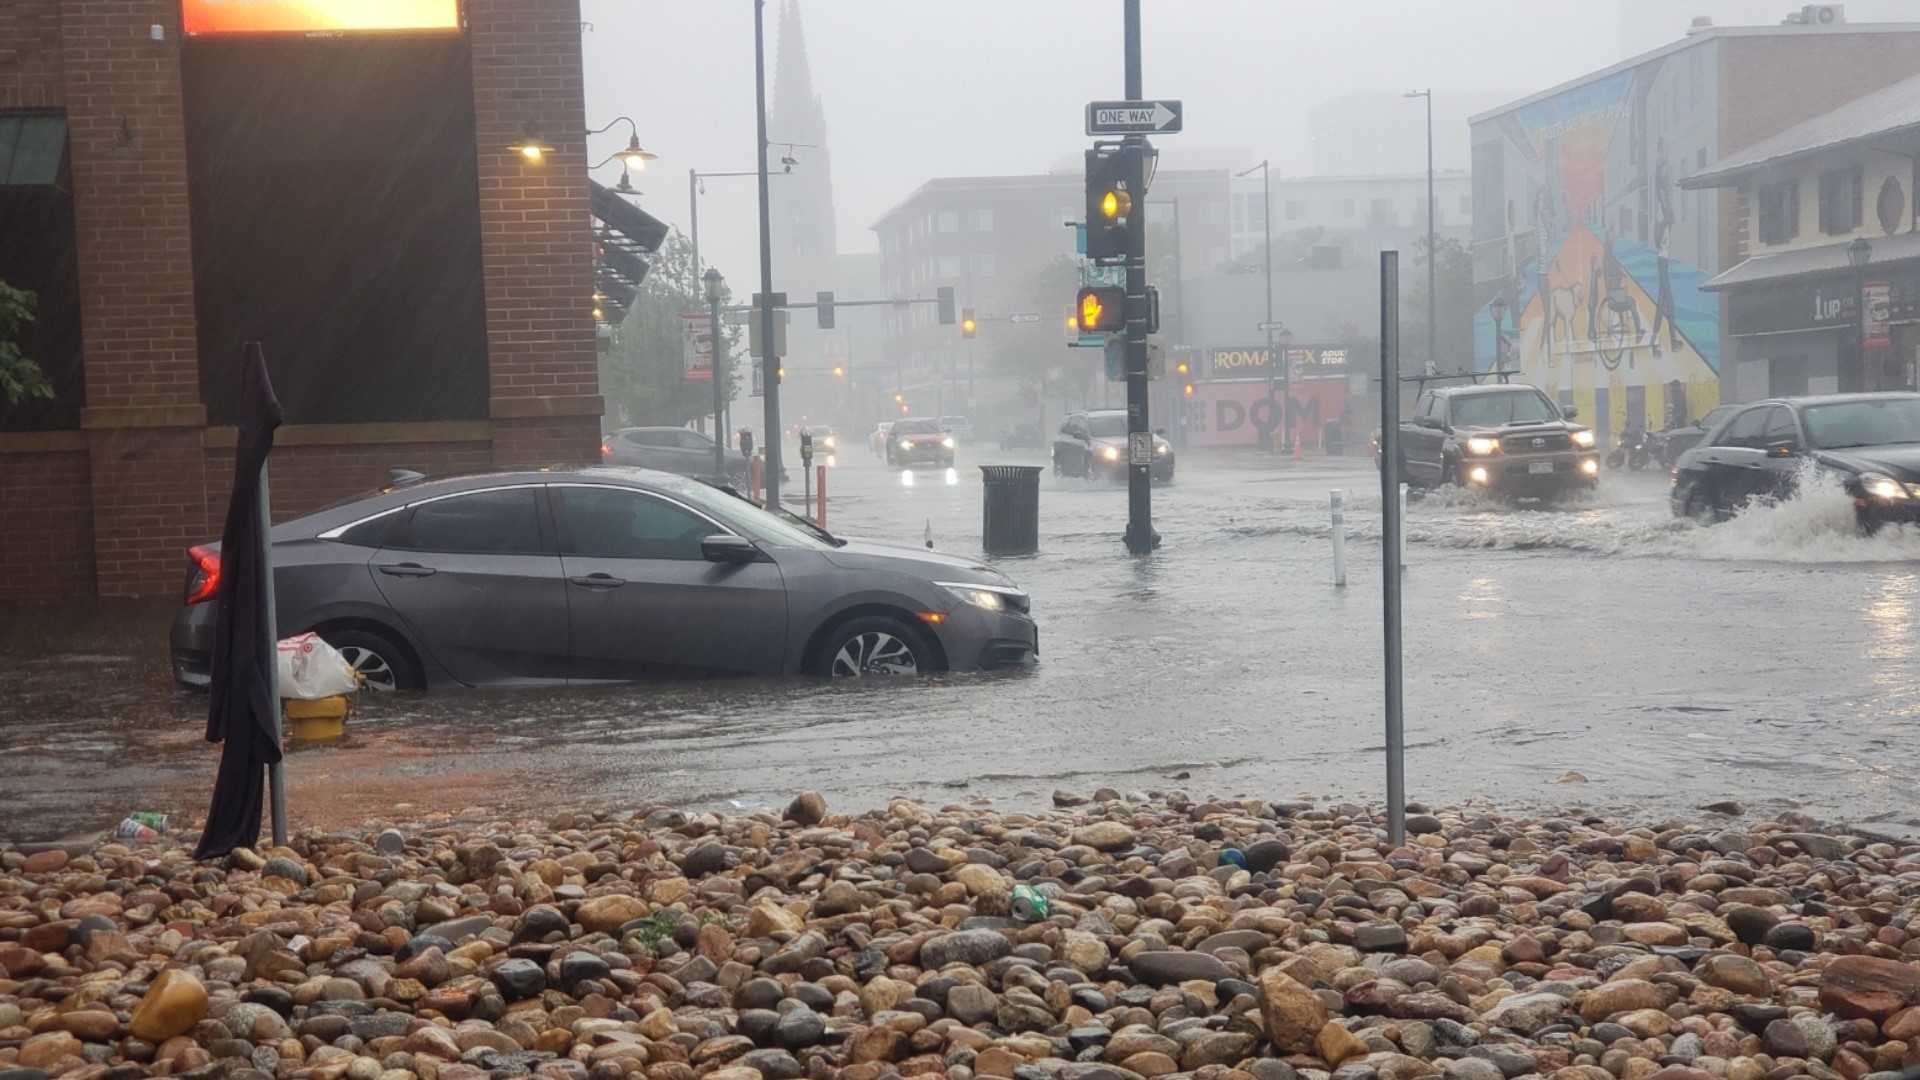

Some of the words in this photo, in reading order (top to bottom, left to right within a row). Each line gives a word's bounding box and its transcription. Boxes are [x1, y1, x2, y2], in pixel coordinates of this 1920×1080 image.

[1100, 111, 1125, 124] ONE
[1130, 110, 1154, 122] WAY
[1216, 396, 1320, 432] DOM
